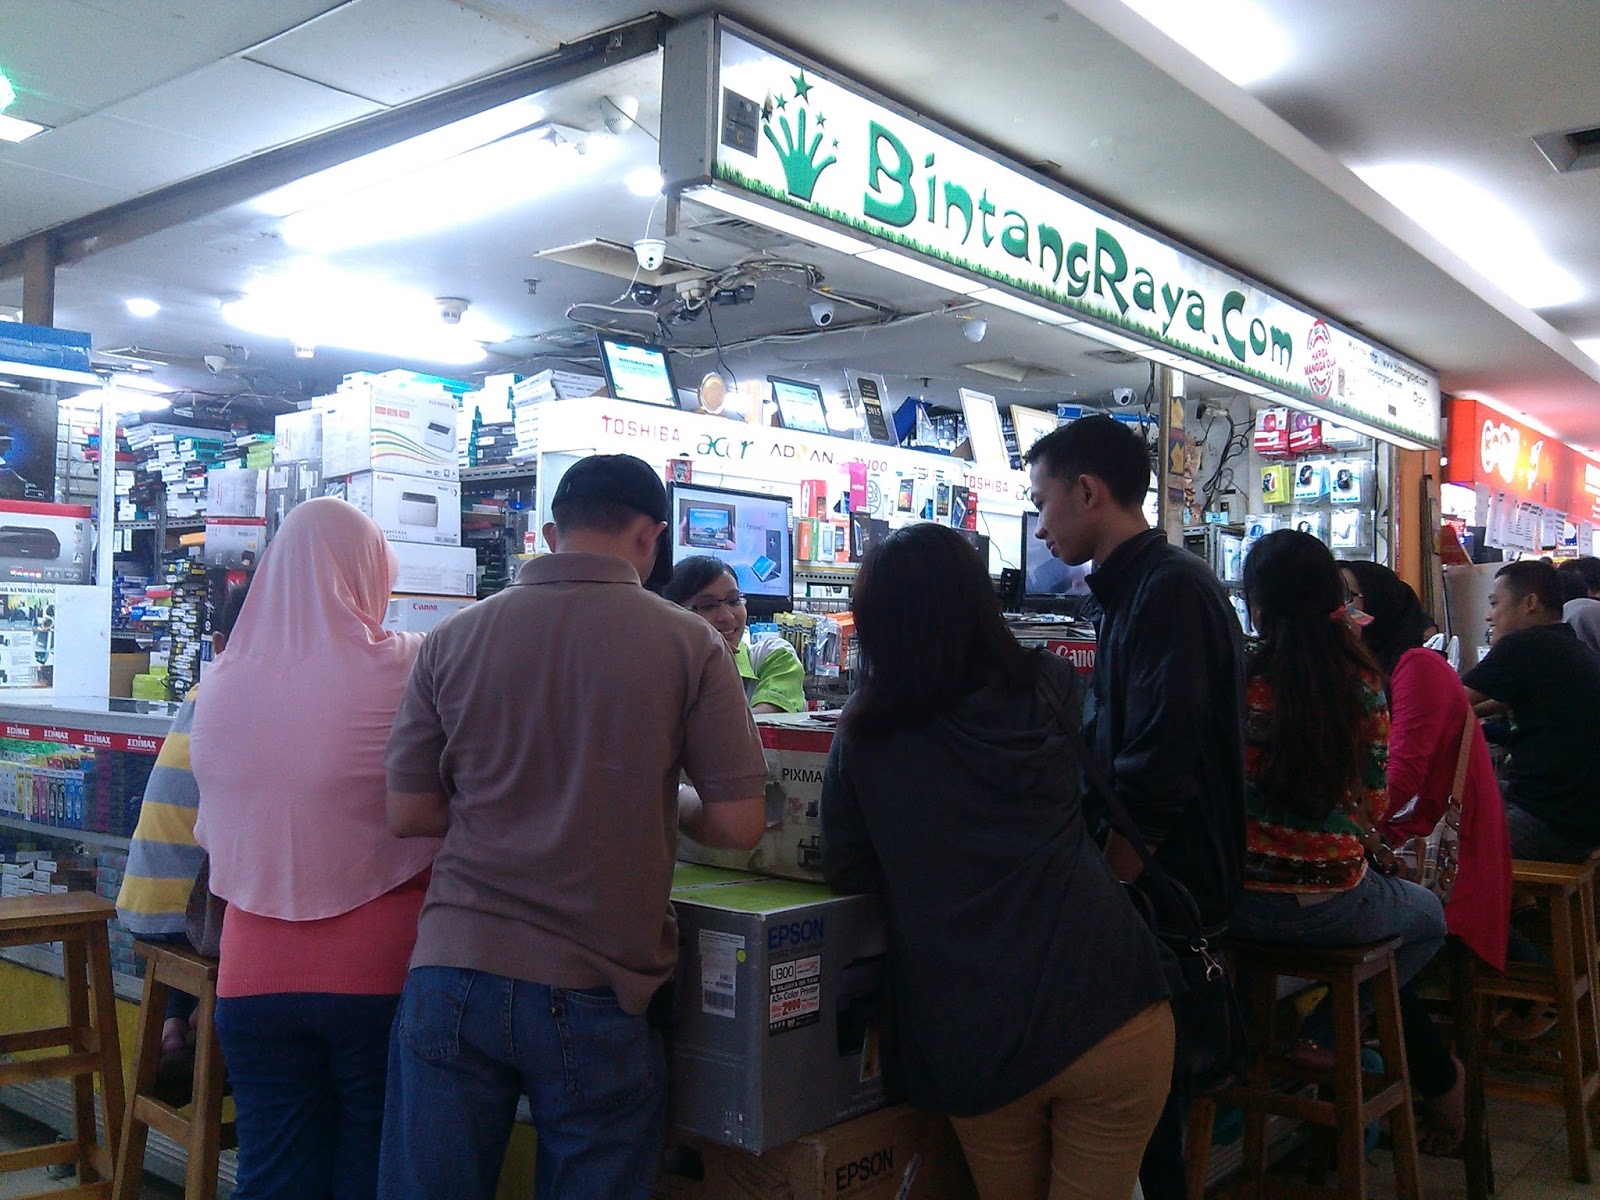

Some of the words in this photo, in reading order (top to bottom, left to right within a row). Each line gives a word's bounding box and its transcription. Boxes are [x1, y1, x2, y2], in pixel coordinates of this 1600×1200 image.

[1303, 360, 1326, 376] MANGGA
[602, 415, 680, 441] TOSHIBA
[697, 434, 754, 459] acer
[770, 443, 834, 464] ADVAN
[963, 473, 1008, 493] TOSHIBA
[1015, 484, 1032, 501] ac
[412, 602, 438, 611] Canon
[1056, 645, 1097, 668] Cano
[782, 768, 823, 783] PIXMA
[768, 917, 825, 950] EPSON
[783, 990, 799, 1001] Color
[800, 986, 818, 996] Printer
[836, 1146, 893, 1191] EPSON
